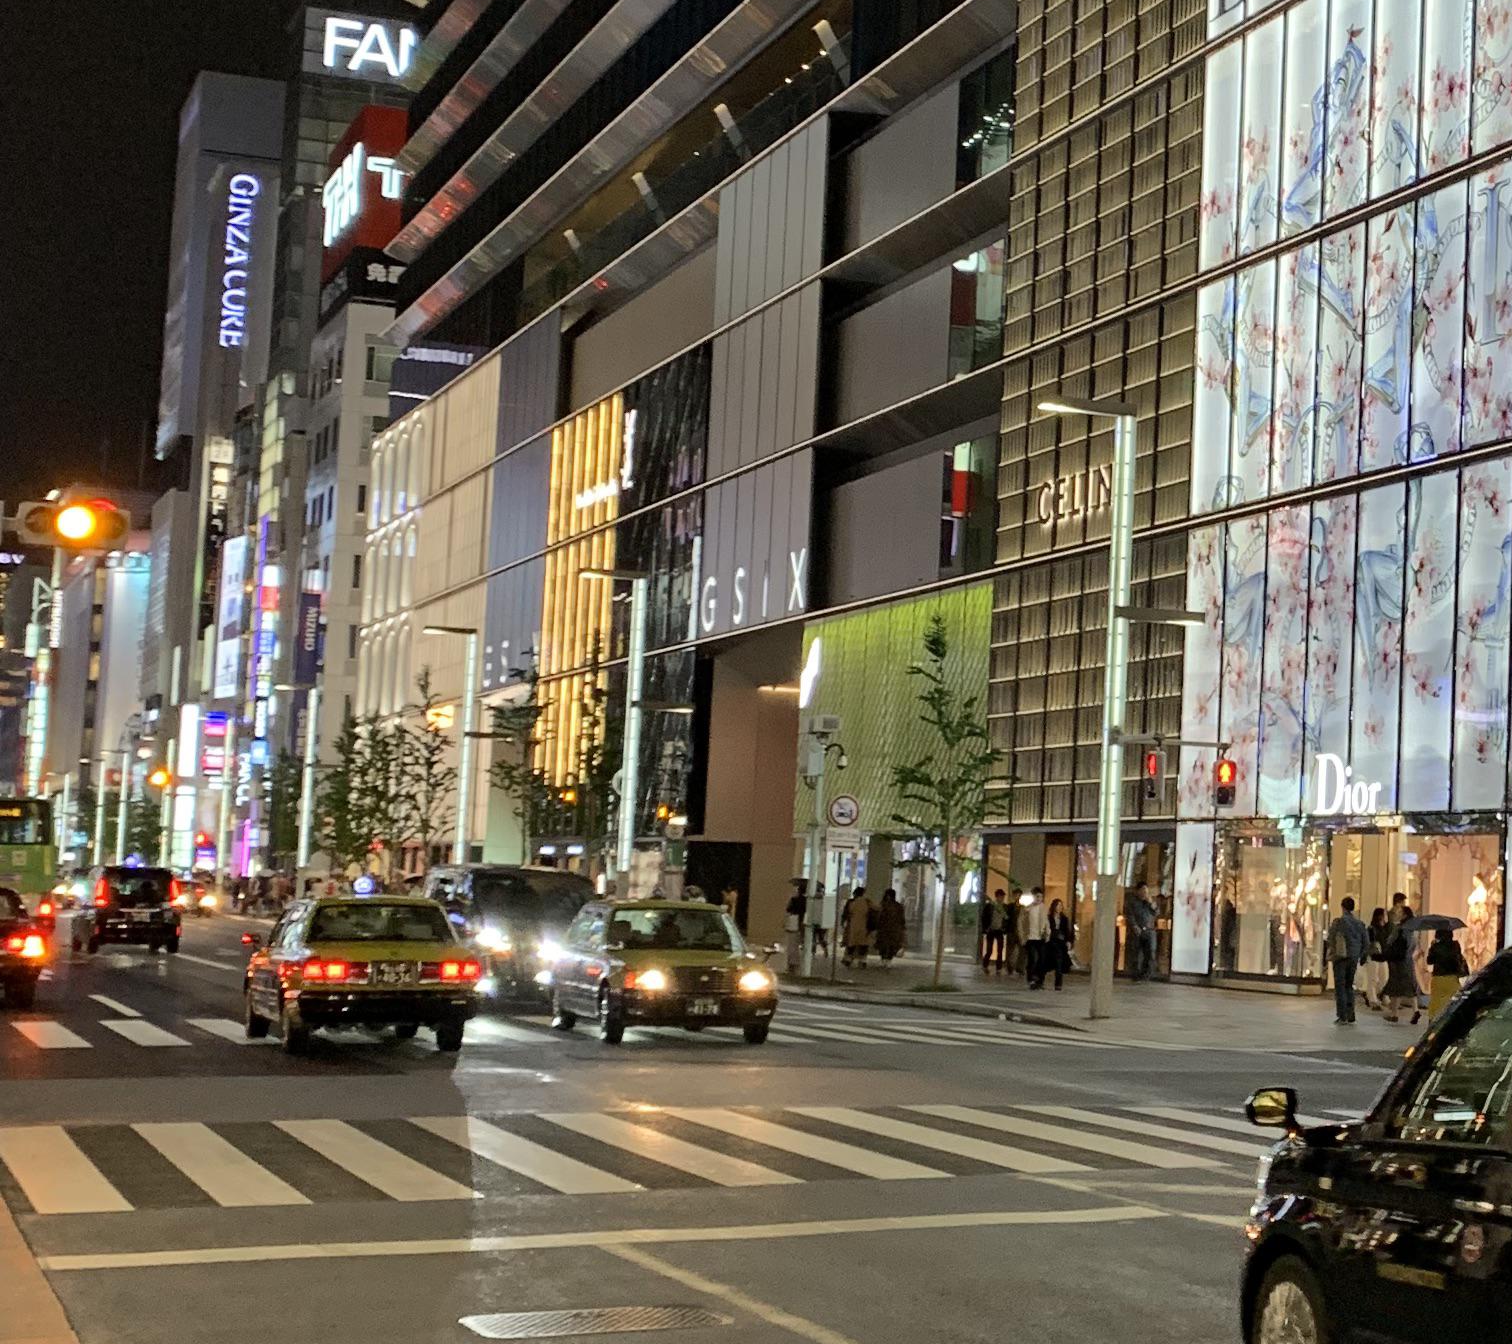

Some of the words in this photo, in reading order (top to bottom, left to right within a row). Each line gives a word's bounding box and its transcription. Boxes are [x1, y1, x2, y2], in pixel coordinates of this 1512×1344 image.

[224, 173, 260, 266] GINZA
[1038, 463, 1113, 525] CELIN
[1312, 753, 1382, 815] Dior
